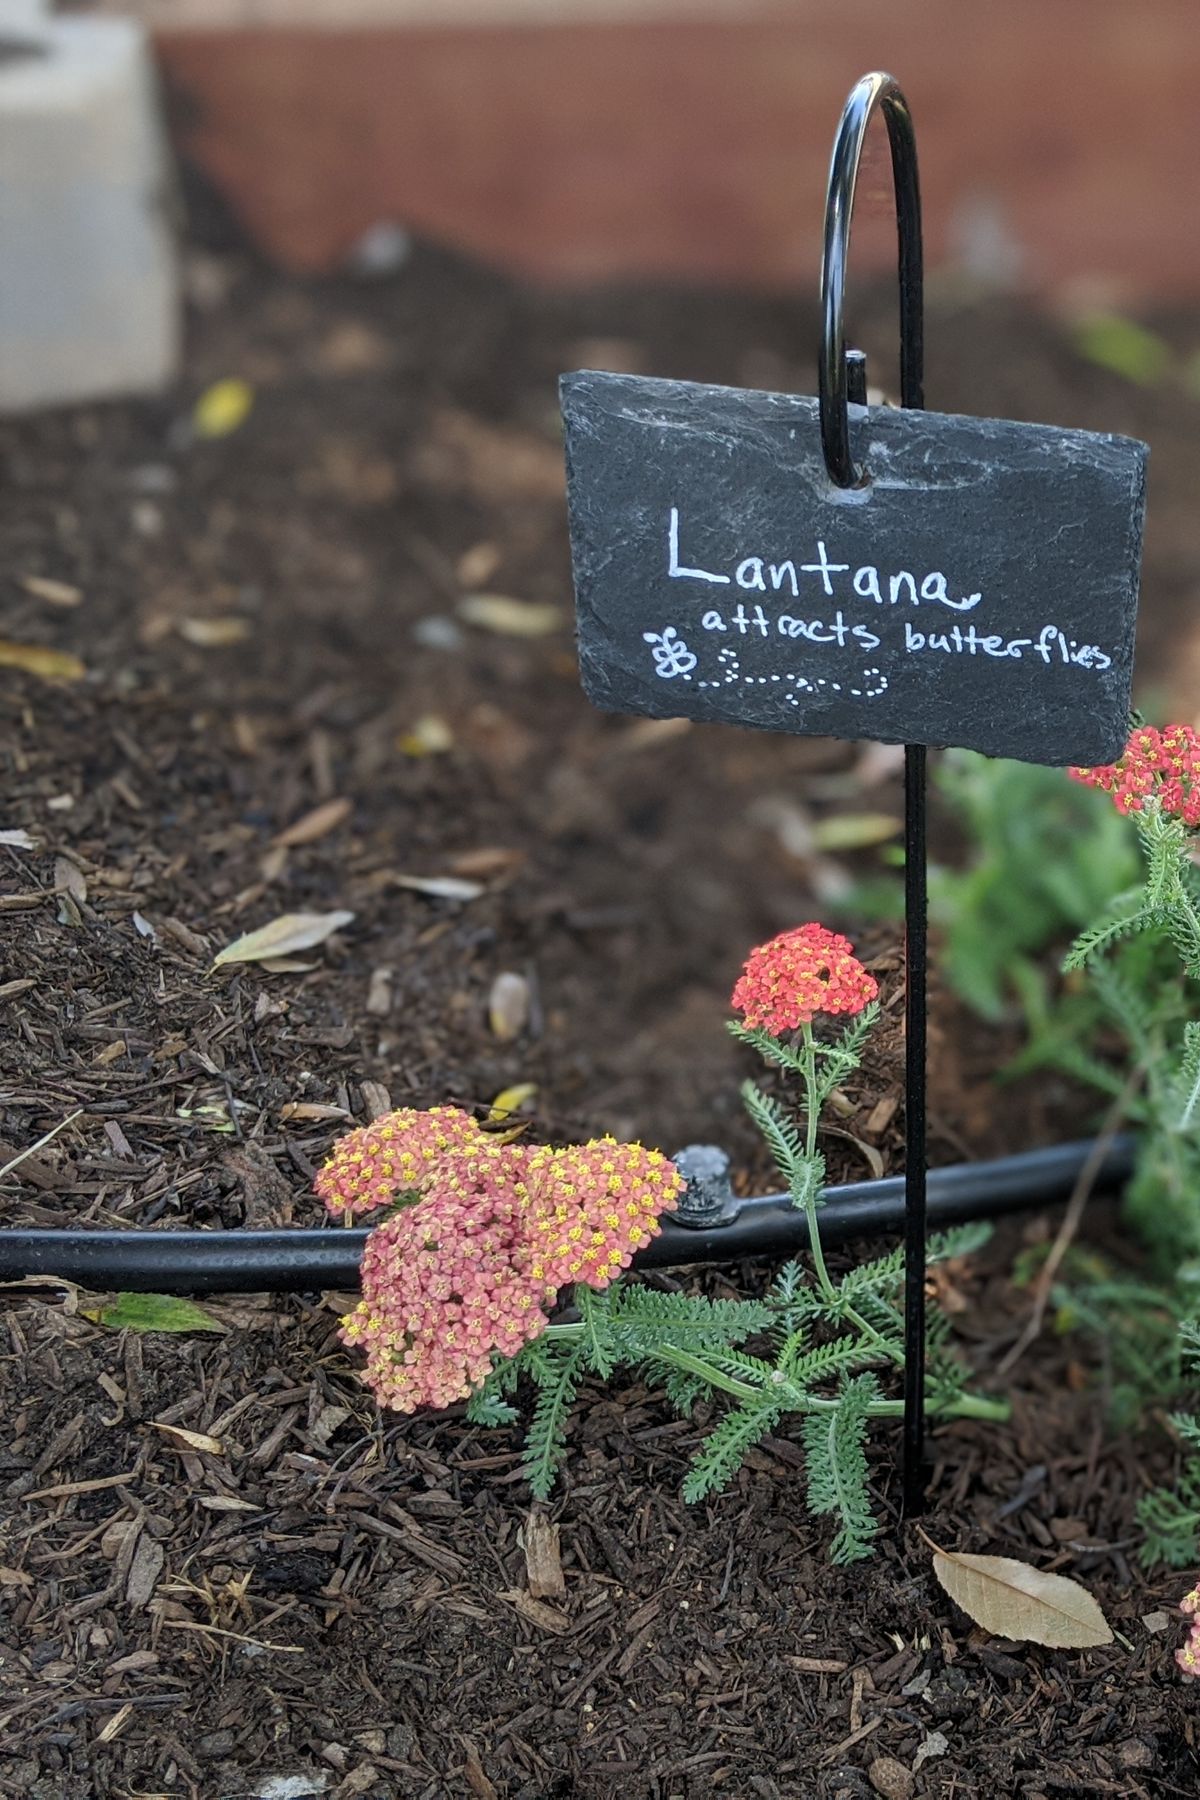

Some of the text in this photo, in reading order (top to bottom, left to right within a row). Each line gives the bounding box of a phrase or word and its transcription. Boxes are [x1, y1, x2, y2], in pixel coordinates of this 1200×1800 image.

[668, 507, 982, 610] Lantana
[702, 605, 1112, 669] attracts butterflies
